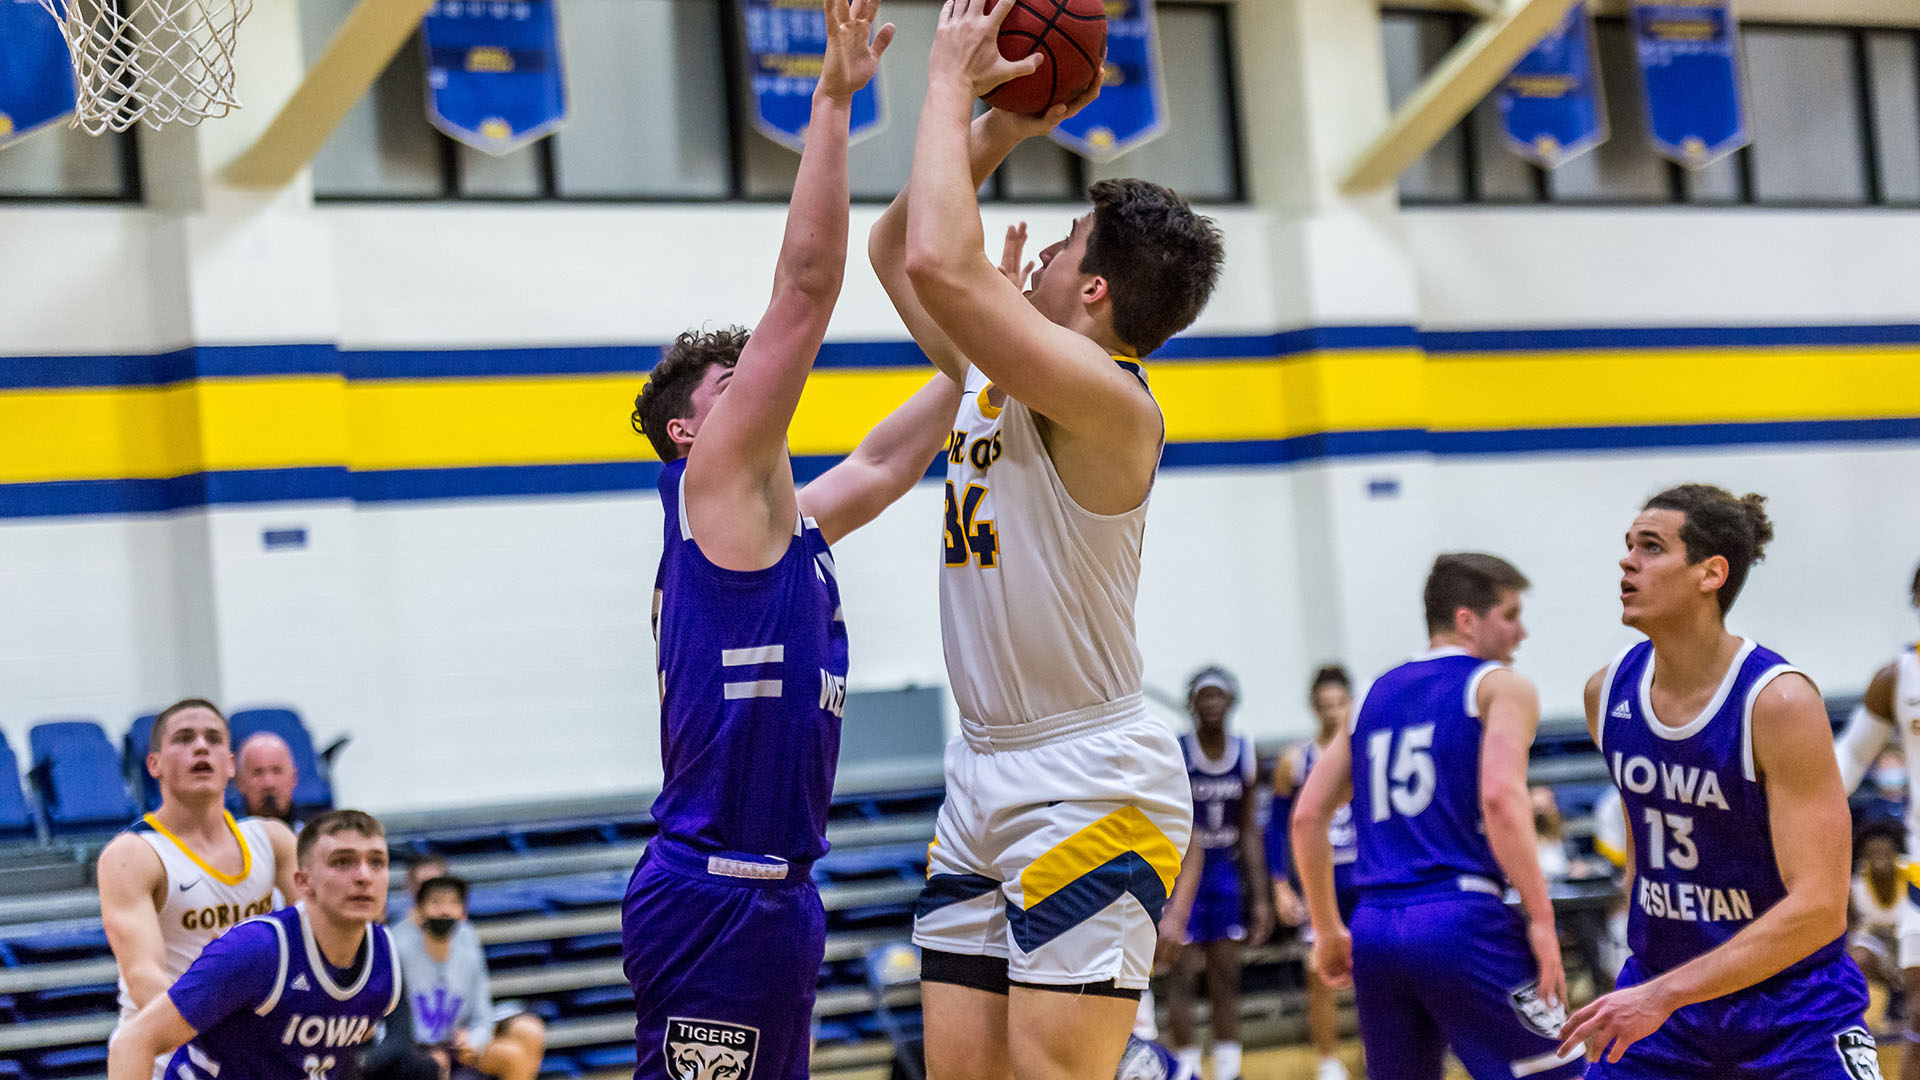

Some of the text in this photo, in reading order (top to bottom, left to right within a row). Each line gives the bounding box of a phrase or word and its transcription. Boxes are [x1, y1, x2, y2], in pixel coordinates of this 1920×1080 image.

[944, 480, 1000, 568] 34
[1368, 723, 1437, 823] 15
[1614, 751, 1731, 811] IOWA
[1644, 807, 1699, 871] 13
[281, 1014, 370, 1048] IOWA
[677, 1023, 747, 1045] TIGERS
